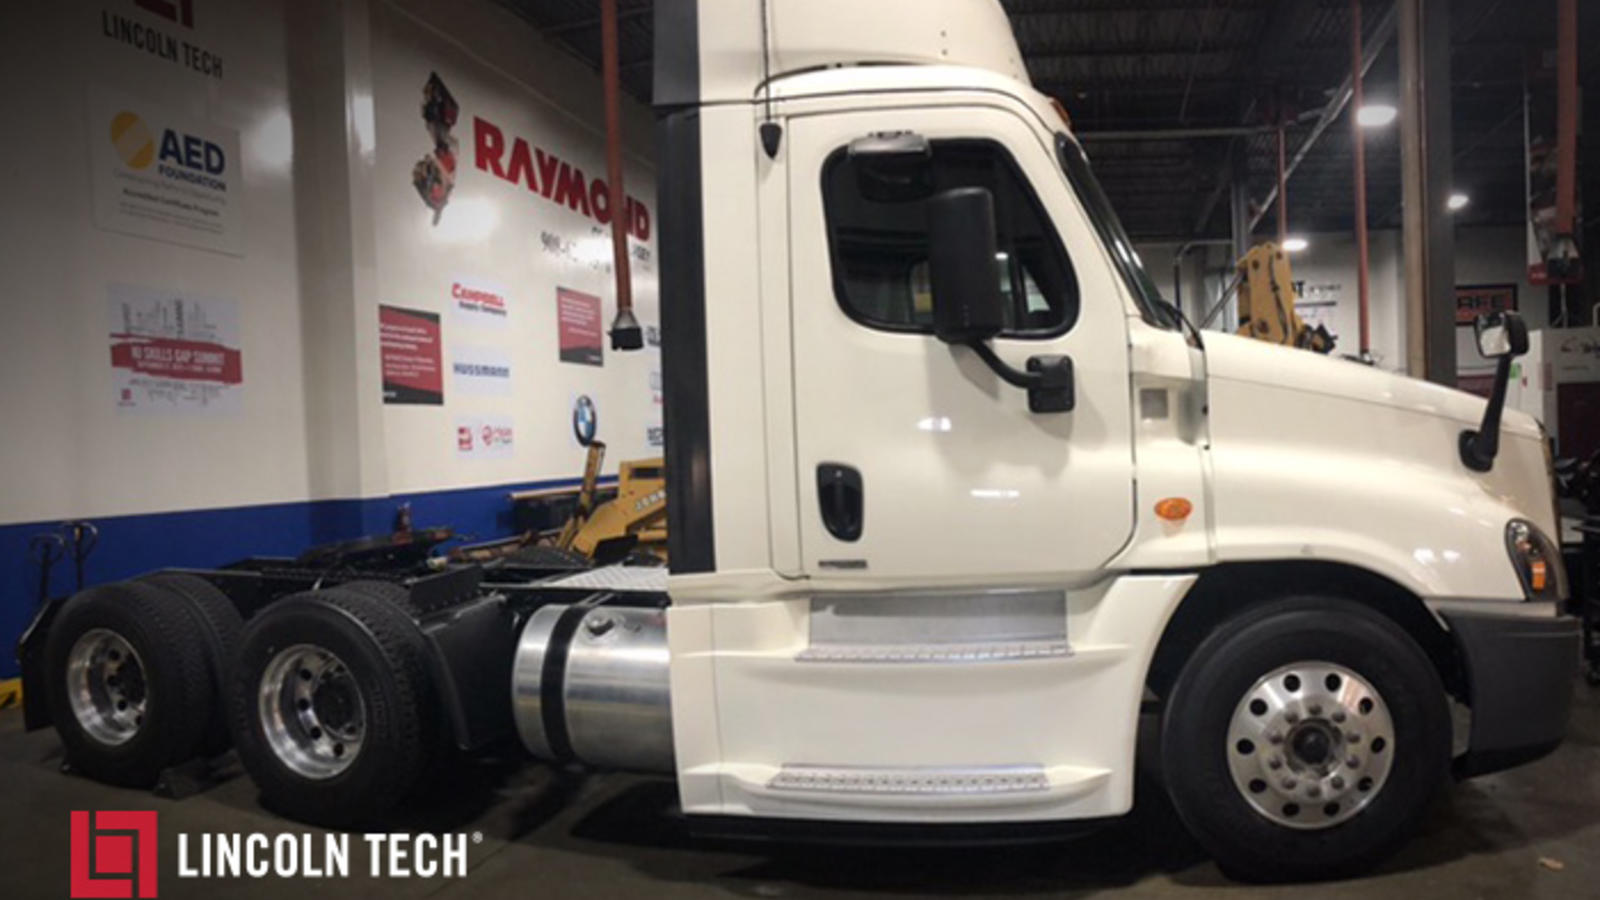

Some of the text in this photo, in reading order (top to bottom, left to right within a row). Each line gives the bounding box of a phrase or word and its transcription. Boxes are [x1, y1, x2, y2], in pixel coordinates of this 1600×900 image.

[101, 9, 224, 79] LINCOLN TECH
[159, 128, 226, 175] AED
[158, 164, 228, 193] FOUNDATION
